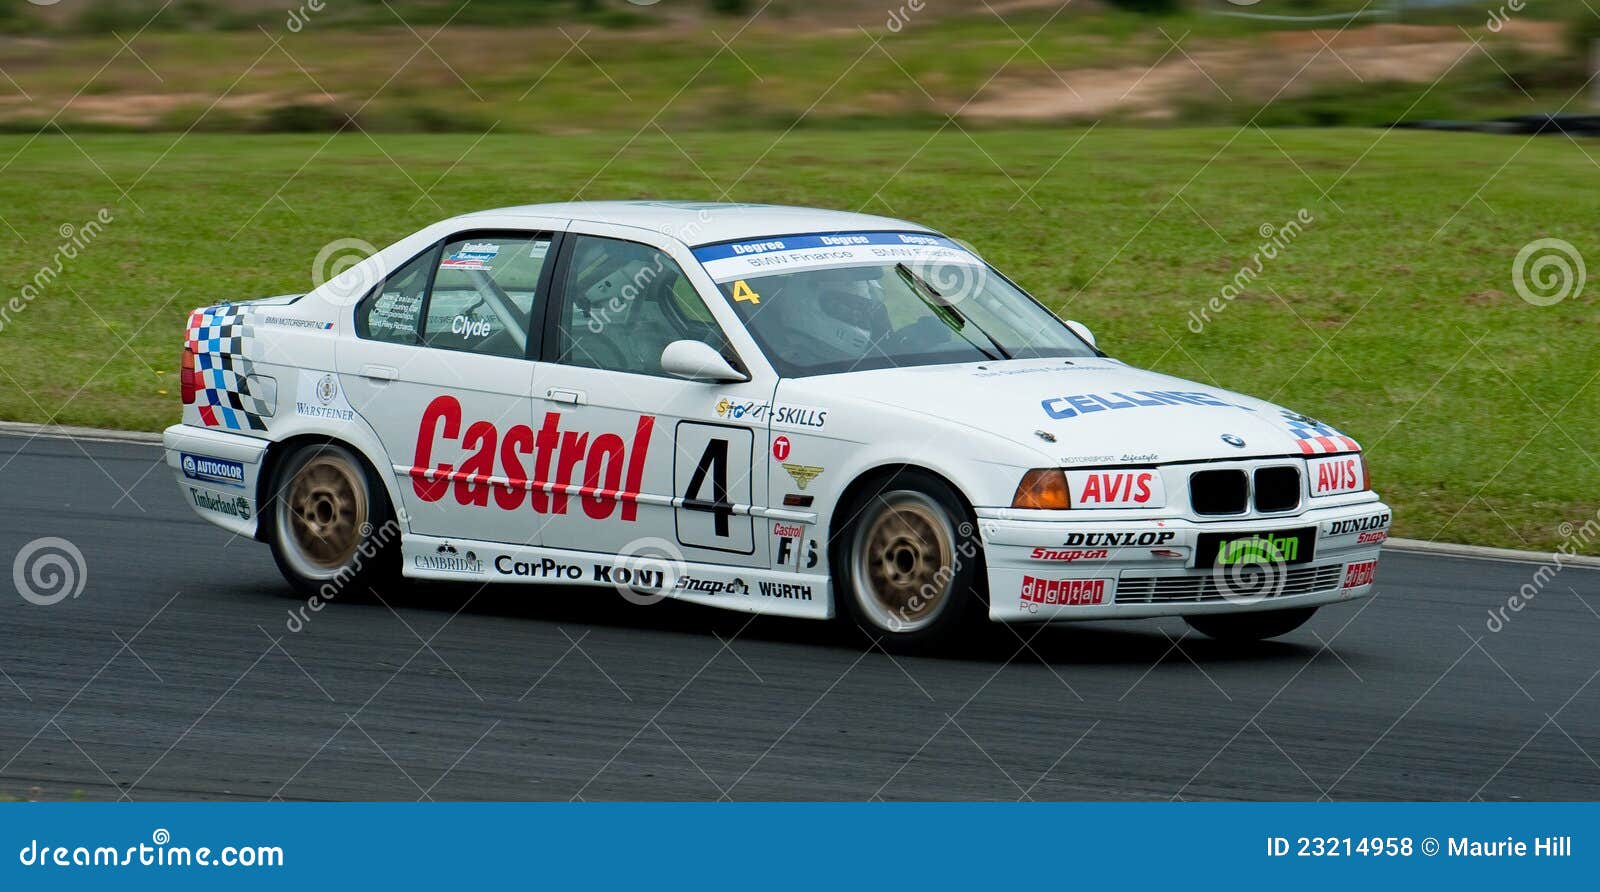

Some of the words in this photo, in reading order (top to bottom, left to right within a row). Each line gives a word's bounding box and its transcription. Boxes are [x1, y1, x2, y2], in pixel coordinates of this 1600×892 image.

[732, 241, 786, 254] Degree
[820, 236, 870, 246] Degree
[747, 256, 788, 267] BMW
[789, 250, 854, 262] Finance
[732, 279, 761, 305] 4
[452, 315, 491, 340] Clyde
[296, 402, 354, 421] WARSTEINER
[776, 407, 827, 427] SKILLS
[197, 460, 242, 479] AUTOCOLOR
[412, 394, 656, 522] Castrol
[683, 438, 736, 537] 4
[1317, 459, 1357, 492] AVIS
[1080, 473, 1152, 503] AVIS
[190, 487, 238, 516] Timberland
[773, 522, 803, 538] Castrol
[1329, 514, 1390, 535] DUNLOP
[1064, 532, 1176, 546] DUNLOP
[1218, 533, 1299, 564] uniden
[1030, 546, 1109, 564] Snap-on
[494, 555, 583, 580] CarPro
[594, 564, 664, 588] KONI
[1021, 577, 1104, 604] digital
